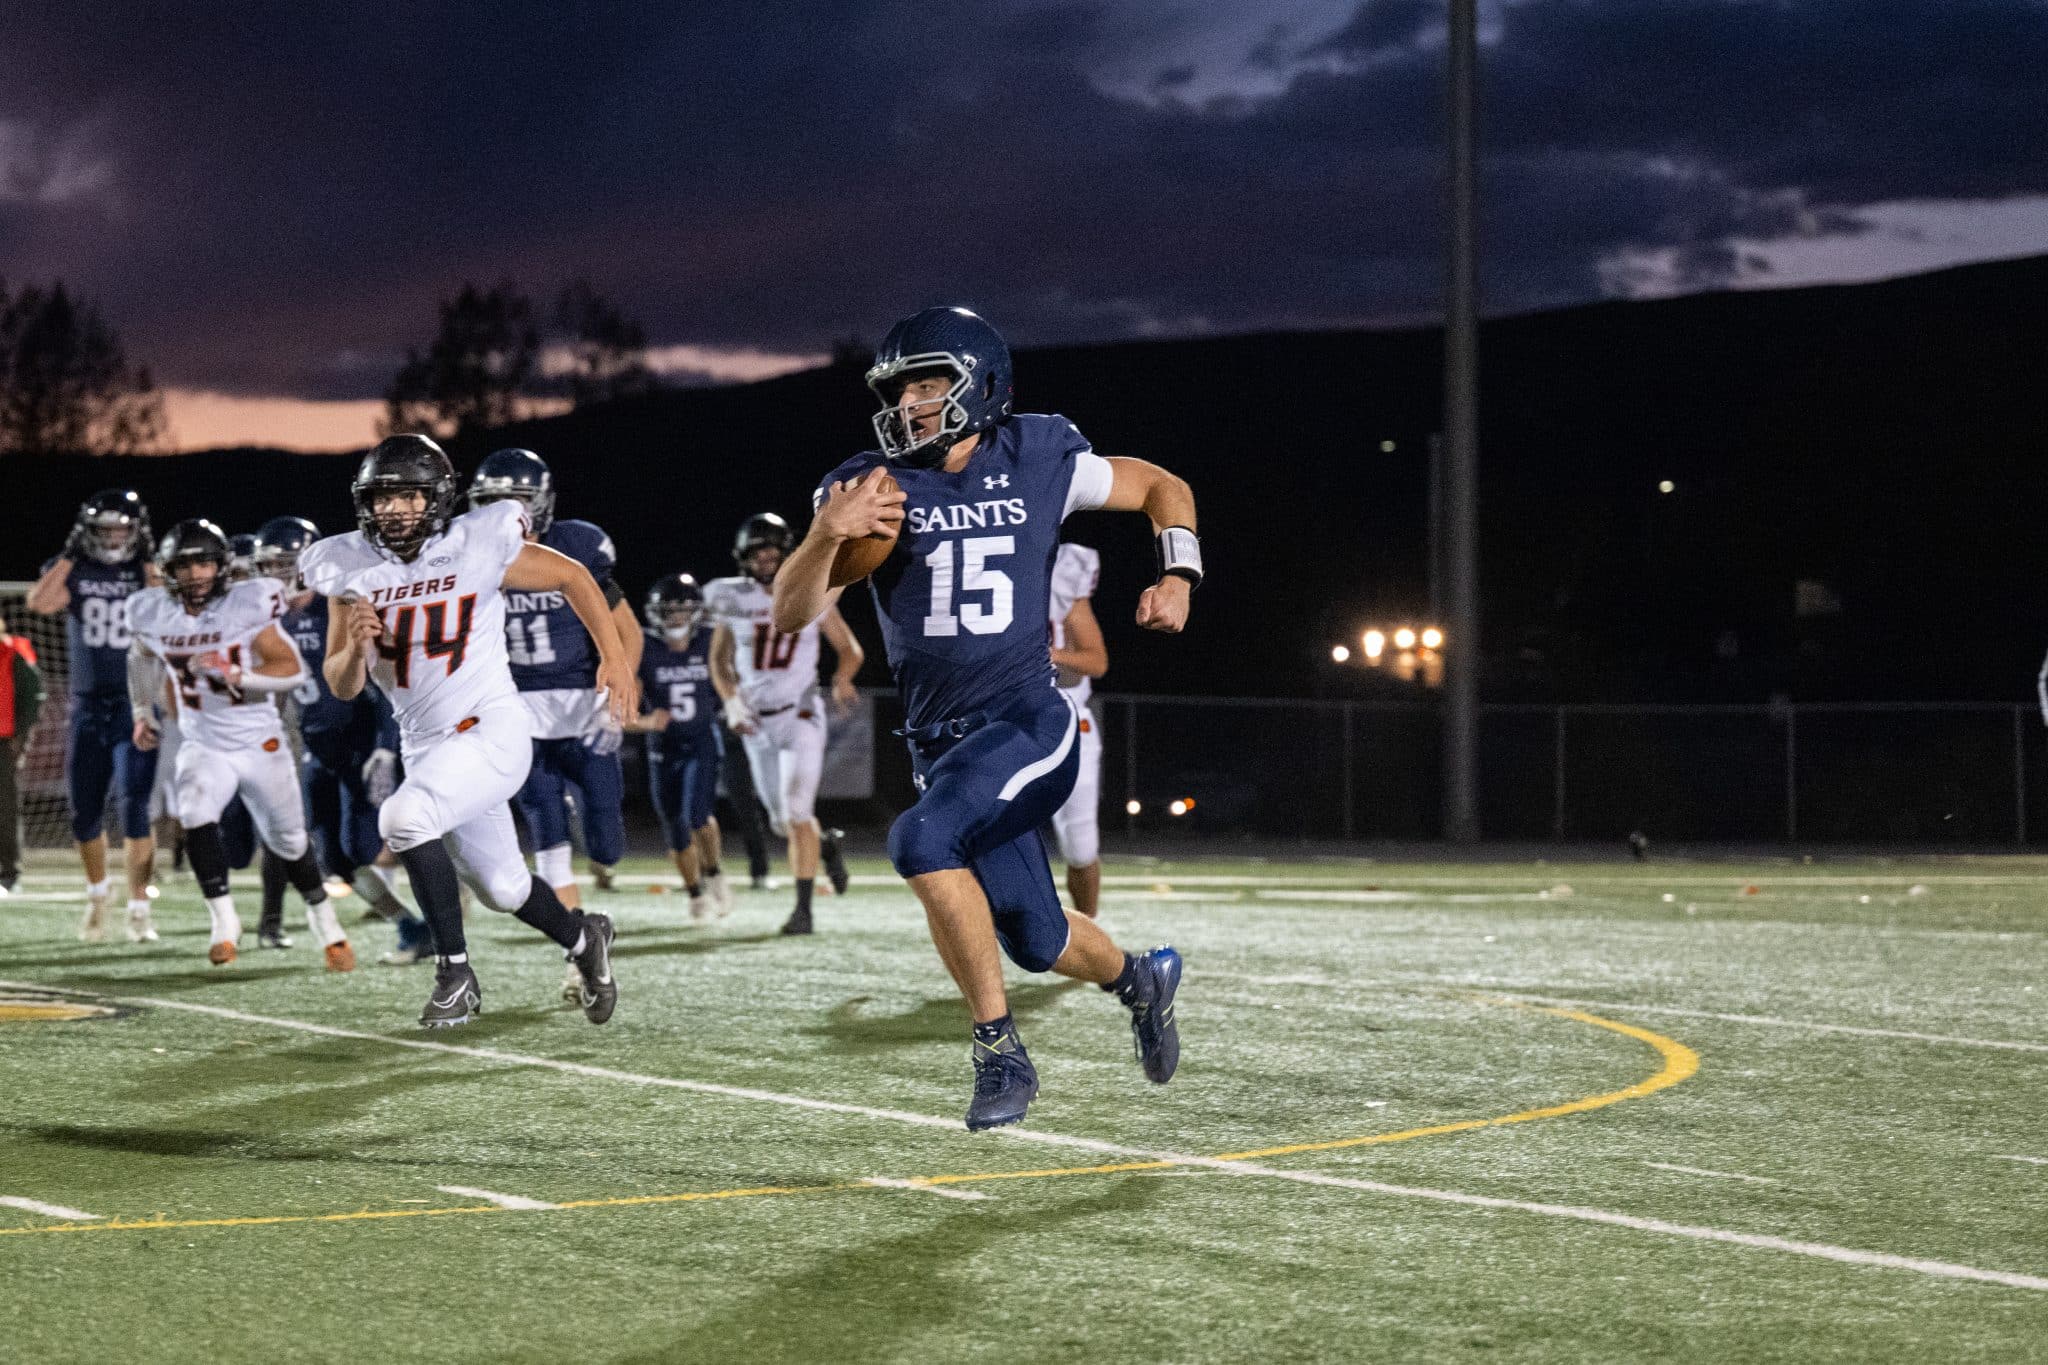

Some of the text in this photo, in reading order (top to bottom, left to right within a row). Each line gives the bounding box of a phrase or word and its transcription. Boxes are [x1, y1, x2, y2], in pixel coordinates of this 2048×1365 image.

[908, 498, 1028, 534] SAINTS
[371, 574, 457, 604] TIGERS
[504, 591, 565, 614] AINTS
[924, 535, 1016, 637] 15
[82, 596, 132, 650] 88
[160, 631, 222, 648] TIGERS
[374, 592, 477, 690] 44
[505, 614, 556, 666] 11
[752, 622, 801, 671] 10
[669, 682, 697, 722] 5
